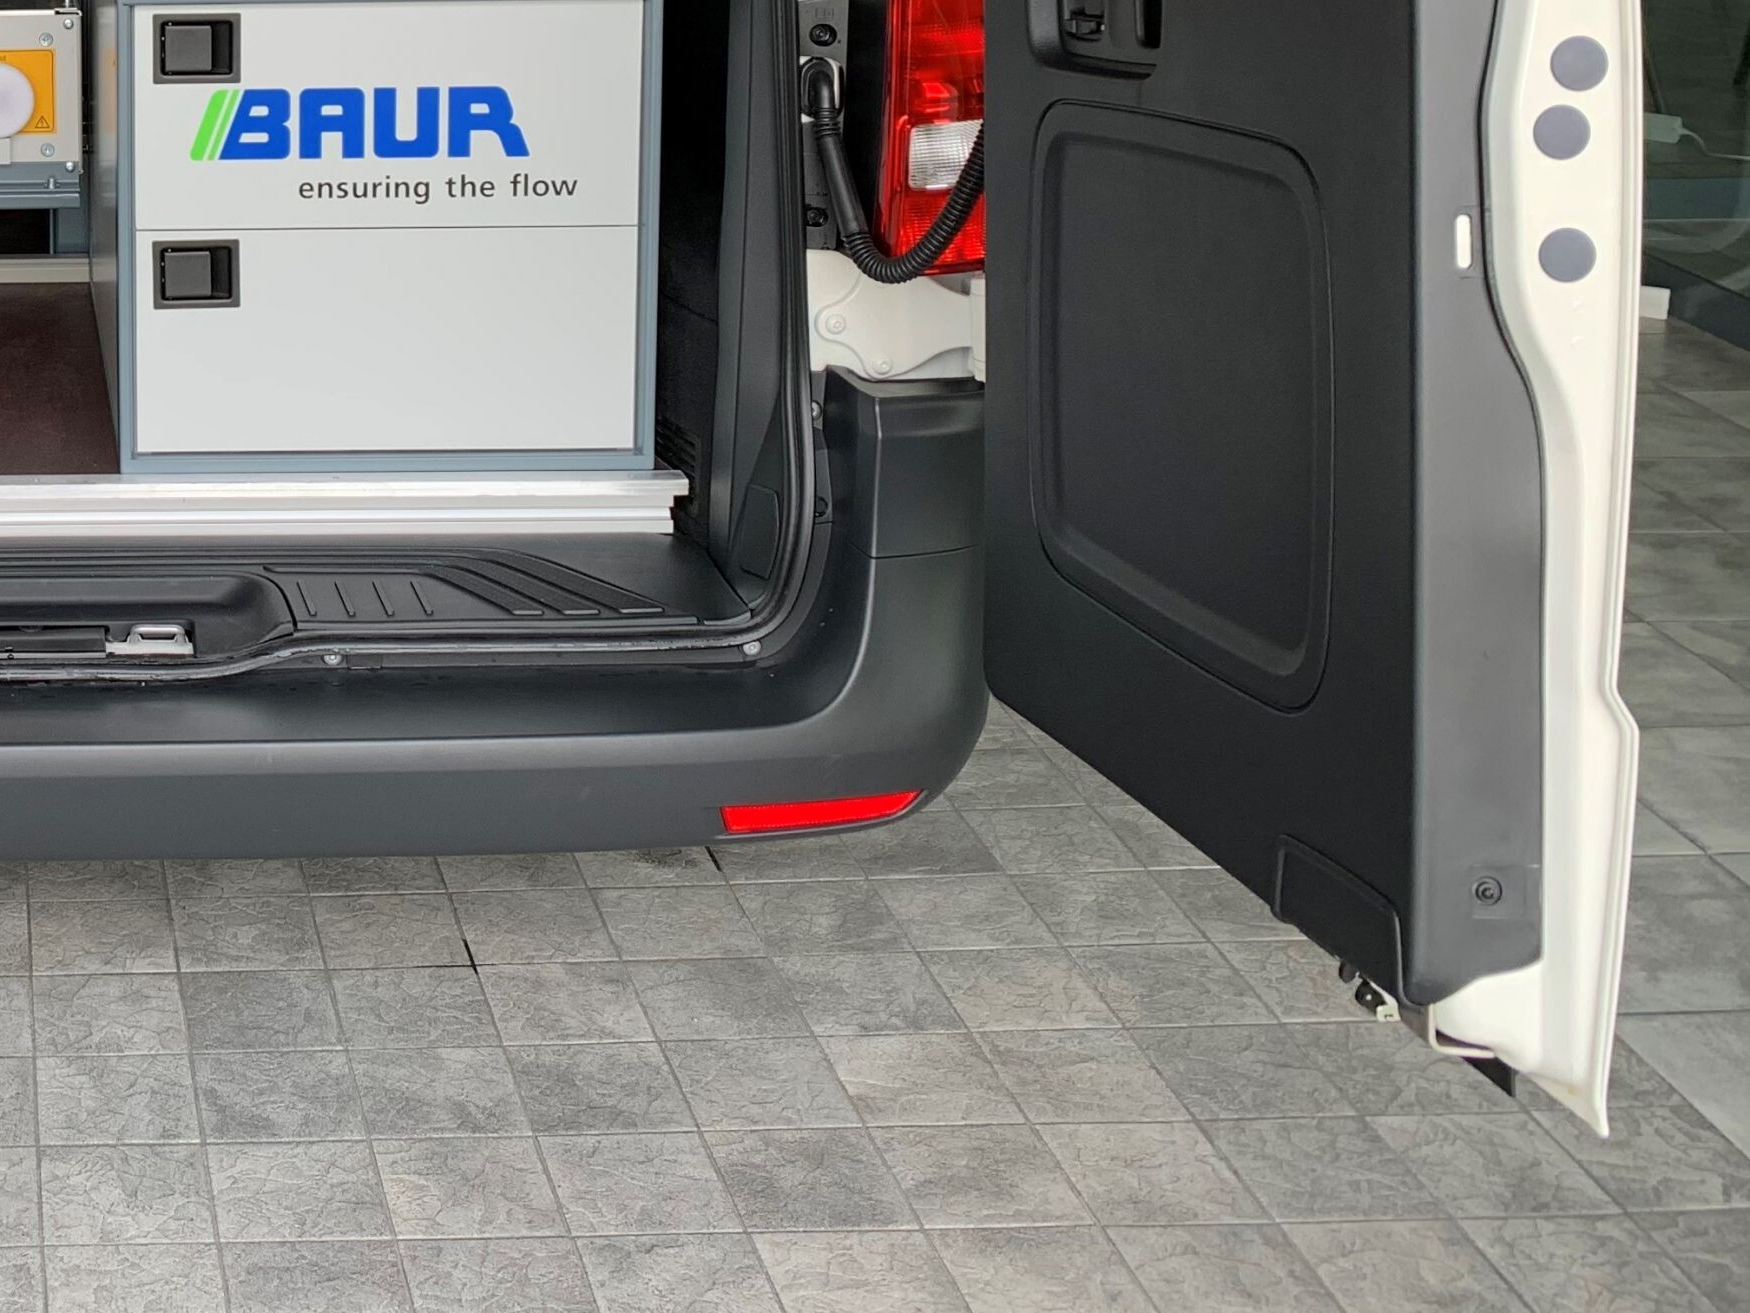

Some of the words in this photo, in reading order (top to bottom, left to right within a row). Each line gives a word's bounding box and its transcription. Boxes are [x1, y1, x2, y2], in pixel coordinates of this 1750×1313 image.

[219, 86, 530, 161] BAUR
[298, 175, 431, 205] ensuring
[445, 174, 496, 198] the
[509, 173, 579, 197] flow
